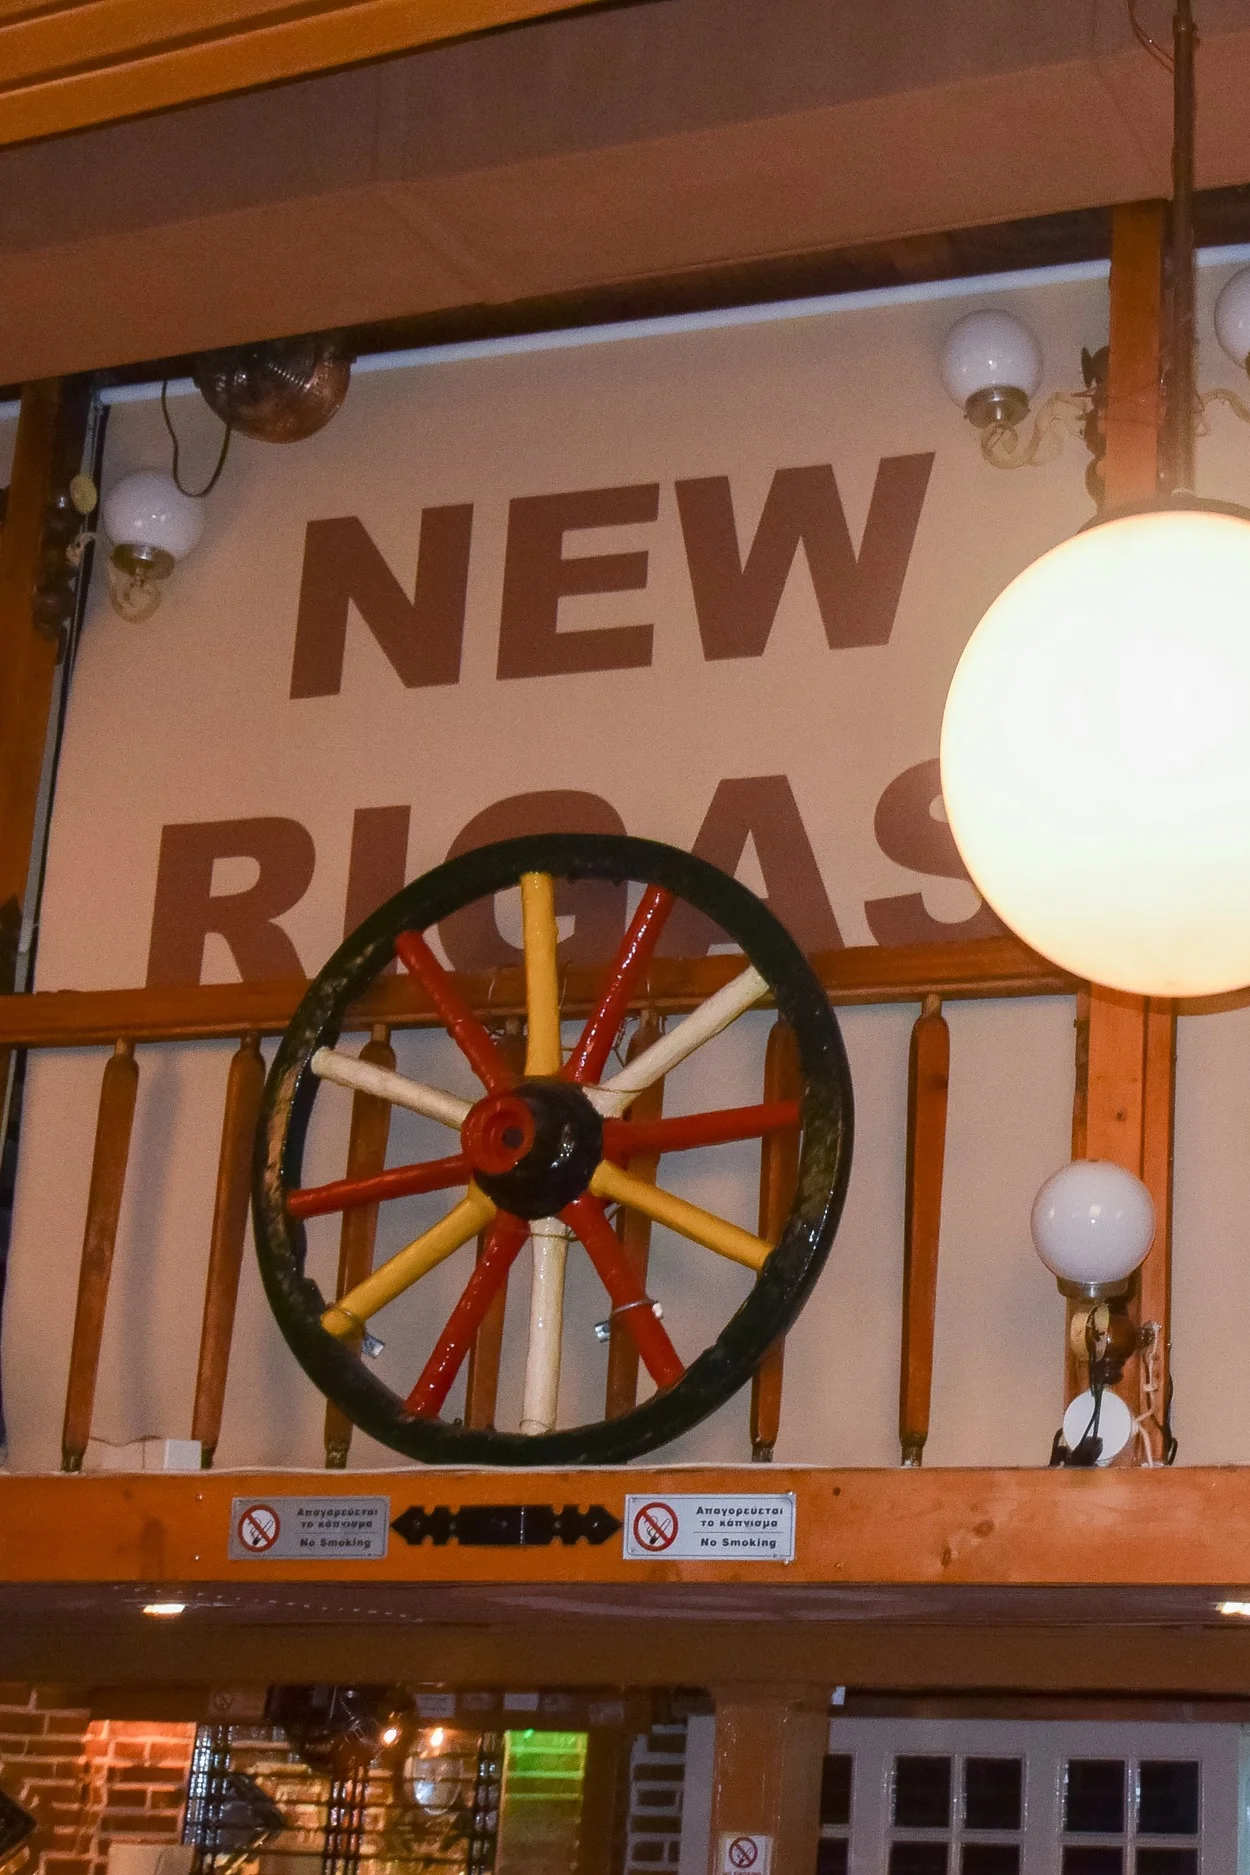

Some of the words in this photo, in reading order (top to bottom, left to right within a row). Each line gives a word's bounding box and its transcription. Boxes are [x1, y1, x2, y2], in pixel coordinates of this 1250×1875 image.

[290, 452, 935, 699] NEW
[695, 1506, 783, 1517] Απαγορεύεται
[719, 1519, 778, 1529] κάπνισμα
[300, 1537, 316, 1547] No
[320, 1537, 372, 1549] Smoking
[700, 1538, 717, 1547] No
[722, 1537, 777, 1549] Smoking
